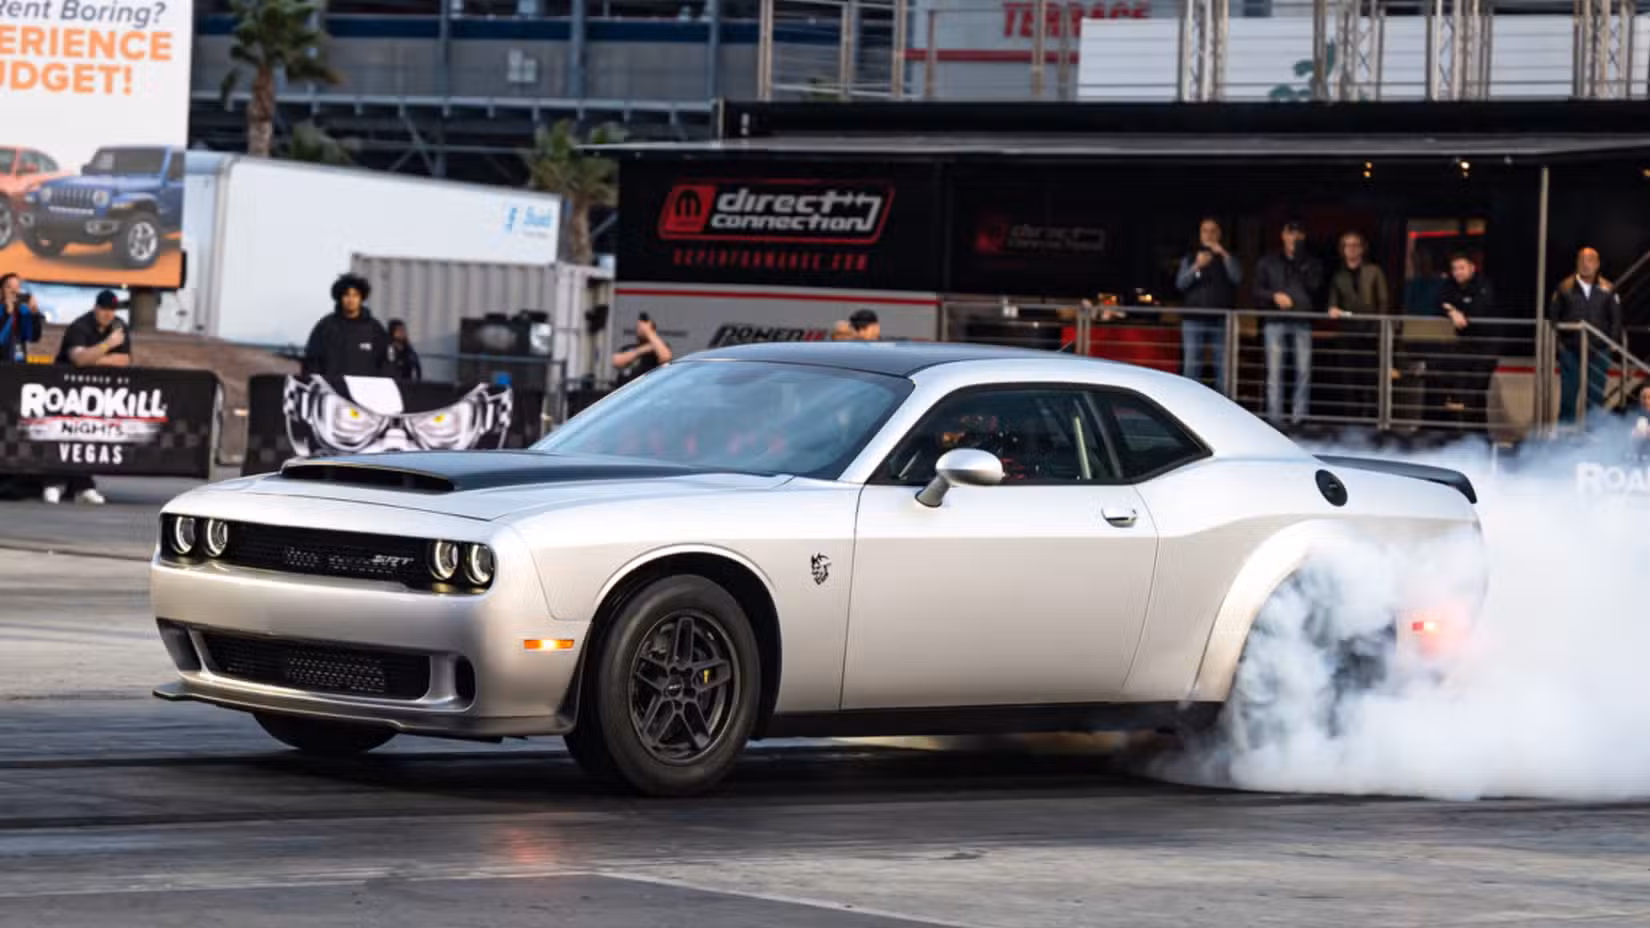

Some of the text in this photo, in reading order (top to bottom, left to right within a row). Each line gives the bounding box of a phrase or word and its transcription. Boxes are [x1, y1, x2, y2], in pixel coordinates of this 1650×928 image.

[60, 0, 166, 29] Boring?
[0, 60, 132, 95] DGET!
[716, 188, 858, 213] direct
[710, 213, 876, 231] connection
[59, 443, 123, 464] VEGAS
[1576, 463, 1650, 494] ROA
